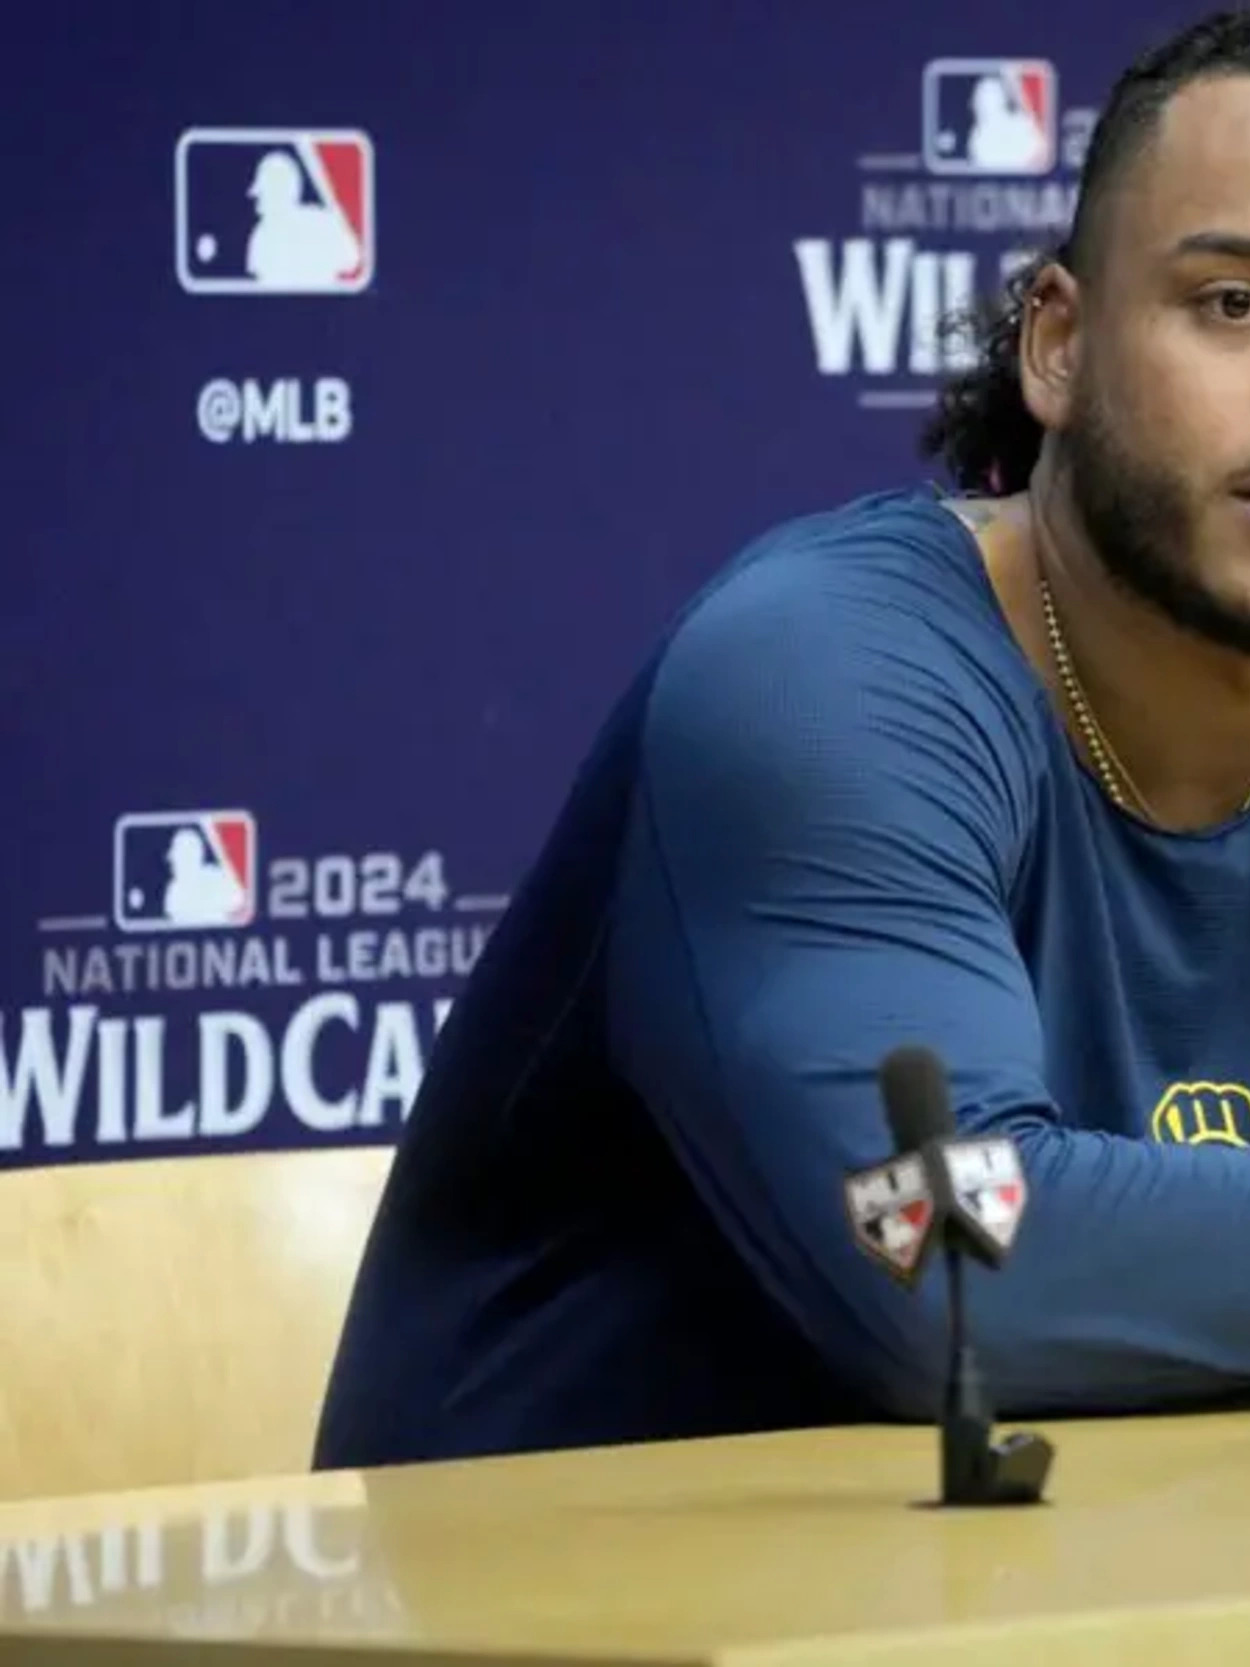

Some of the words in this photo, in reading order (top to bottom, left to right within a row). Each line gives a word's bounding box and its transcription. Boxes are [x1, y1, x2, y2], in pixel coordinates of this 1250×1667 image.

[793, 237, 1042, 376] WIL
[196, 376, 352, 444] @MLB
[267, 849, 450, 919] 2024
[42, 937, 304, 997] NATIONAL
[0, 990, 457, 1150] WILDCA
